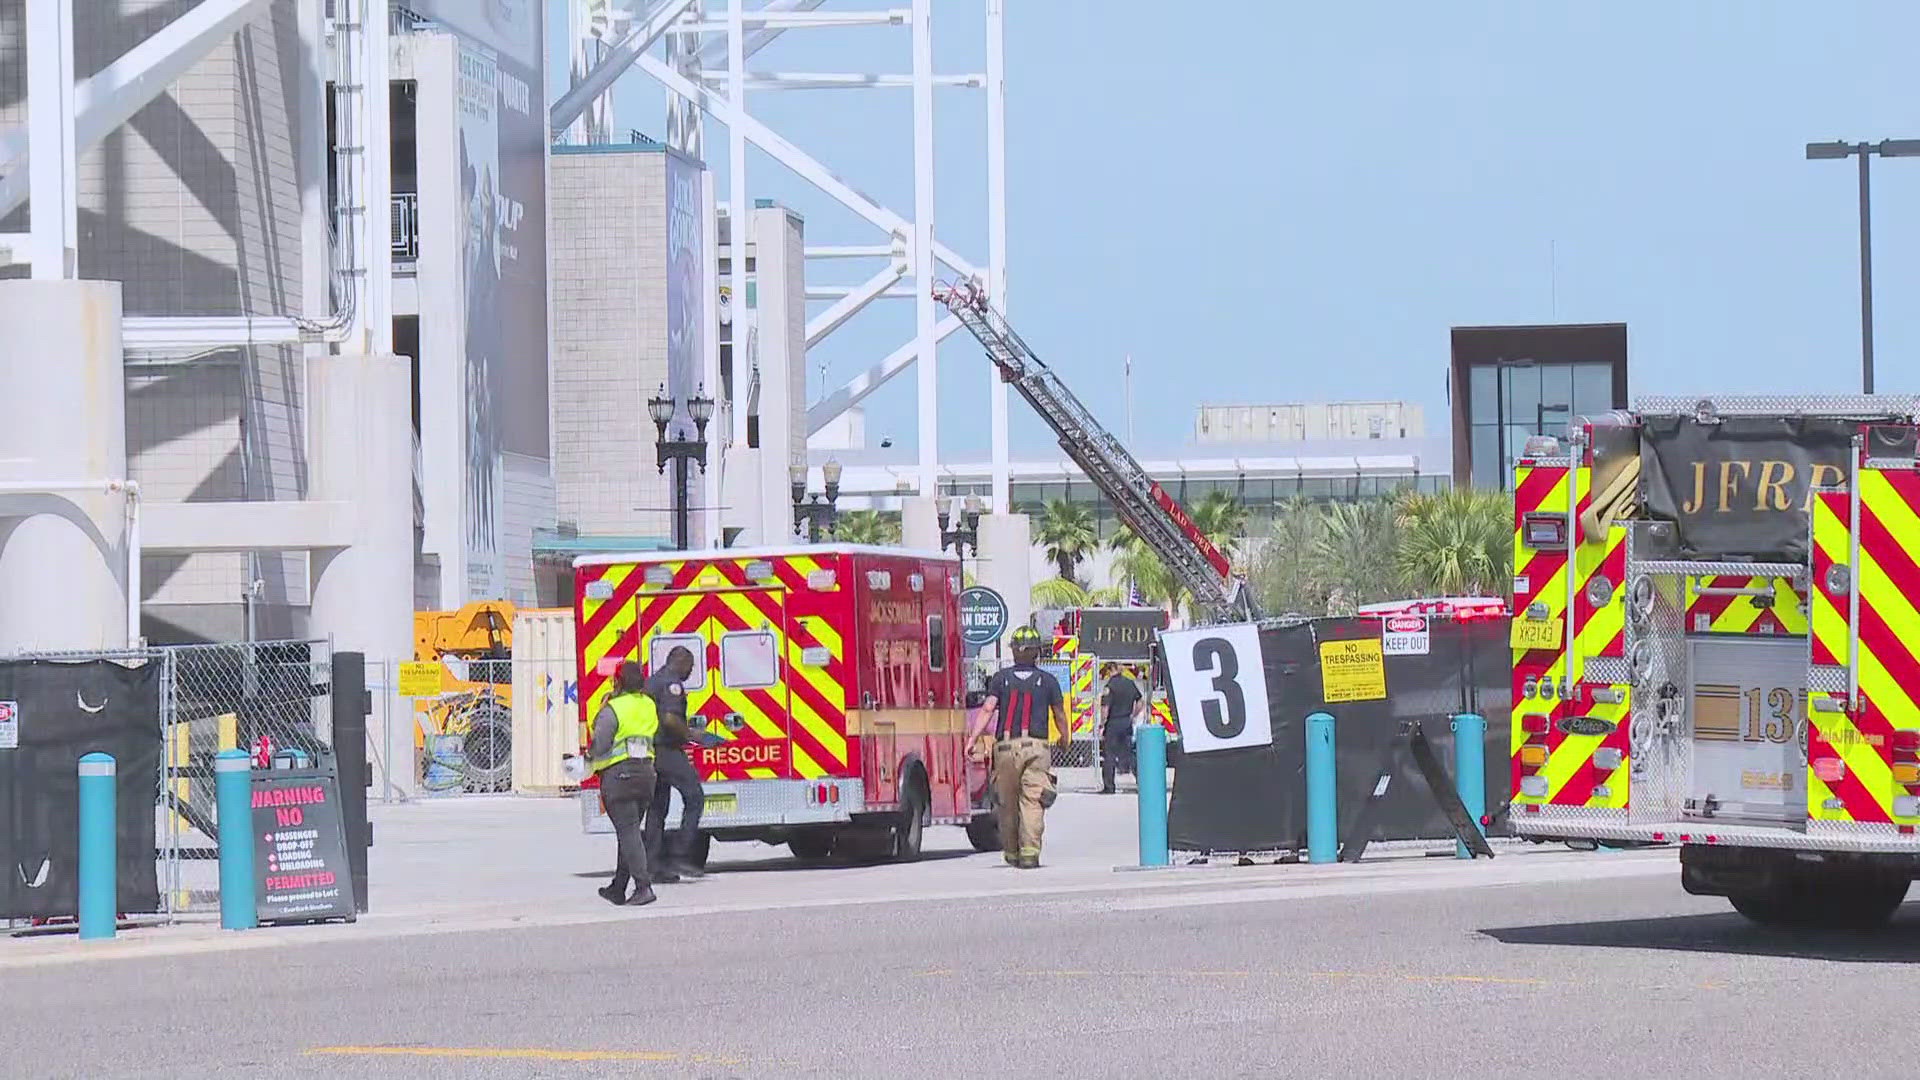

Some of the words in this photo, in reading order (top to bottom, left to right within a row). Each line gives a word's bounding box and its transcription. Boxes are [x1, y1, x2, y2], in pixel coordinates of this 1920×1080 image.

[975, 613, 999, 626] DECK
[1391, 619, 1422, 629] DANGER
[1094, 627, 1149, 642] JFRD
[1345, 643, 1358, 653] NO
[1385, 638, 1408, 650] KEEP
[1410, 637, 1427, 650] OUT
[1324, 653, 1380, 665] TRESPASSING
[1193, 637, 1246, 739] 3
[1743, 687, 1794, 743] 13
[703, 745, 782, 764] RESCUE
[251, 786, 325, 808] WARNING
[276, 807, 303, 827] NO
[275, 830, 319, 842] PASSENGER
[277, 840, 314, 852] DROP-OFF
[278, 850, 312, 862] LOADING
[280, 859, 325, 871] UNLOADING
[266, 872, 336, 890] PERMITTED
[267, 895, 288, 904] Please
[289, 891, 314, 903] proceed
[323, 889, 333, 898] Lot
